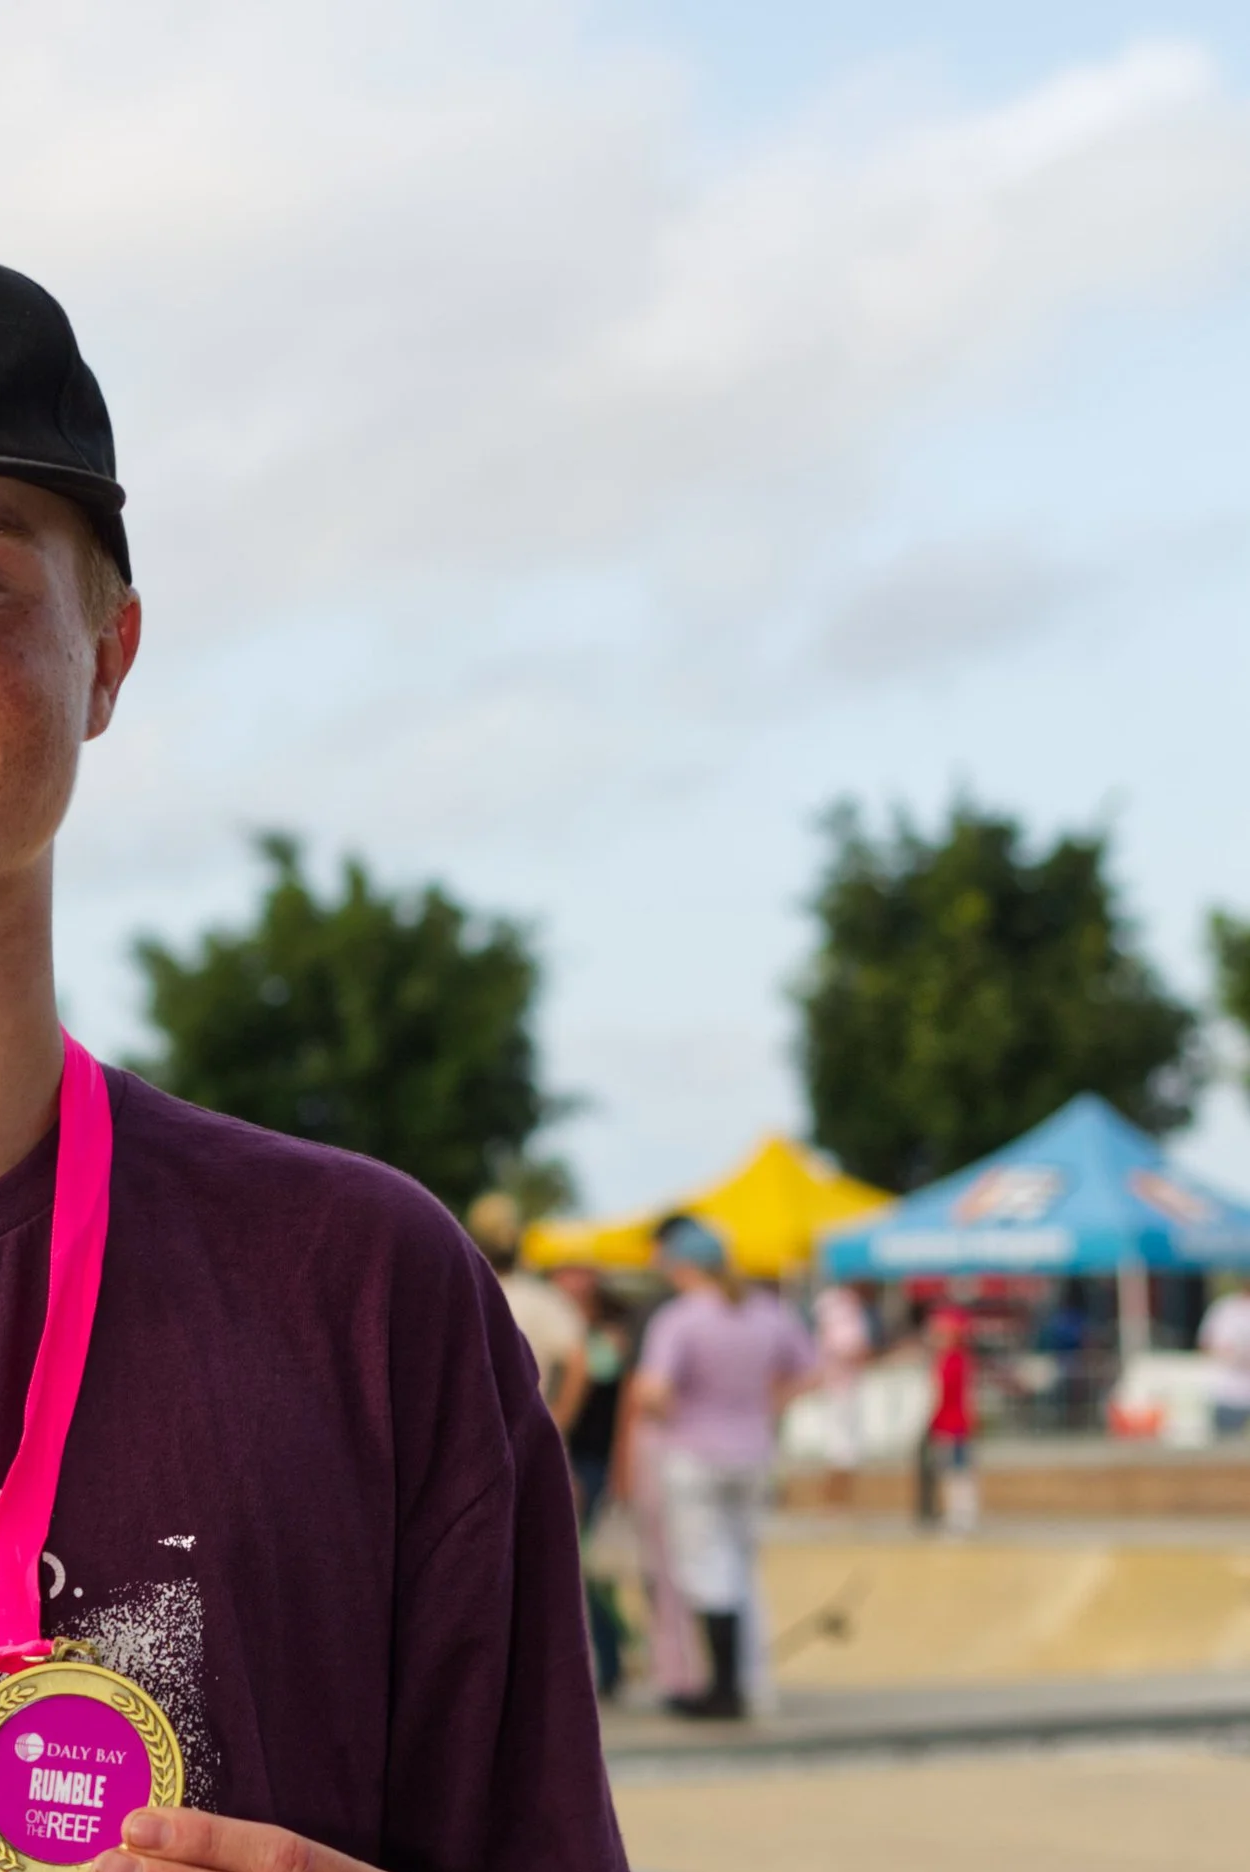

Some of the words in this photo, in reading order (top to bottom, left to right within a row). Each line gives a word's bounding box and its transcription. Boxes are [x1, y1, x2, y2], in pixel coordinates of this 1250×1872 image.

[46, 1742, 92, 1761] DALY
[95, 1748, 127, 1765] BAY
[28, 1767, 107, 1809] RUMBLE
[25, 1808, 49, 1825] ON
[46, 1811, 101, 1843] REEF
[26, 1824, 48, 1838] THE
